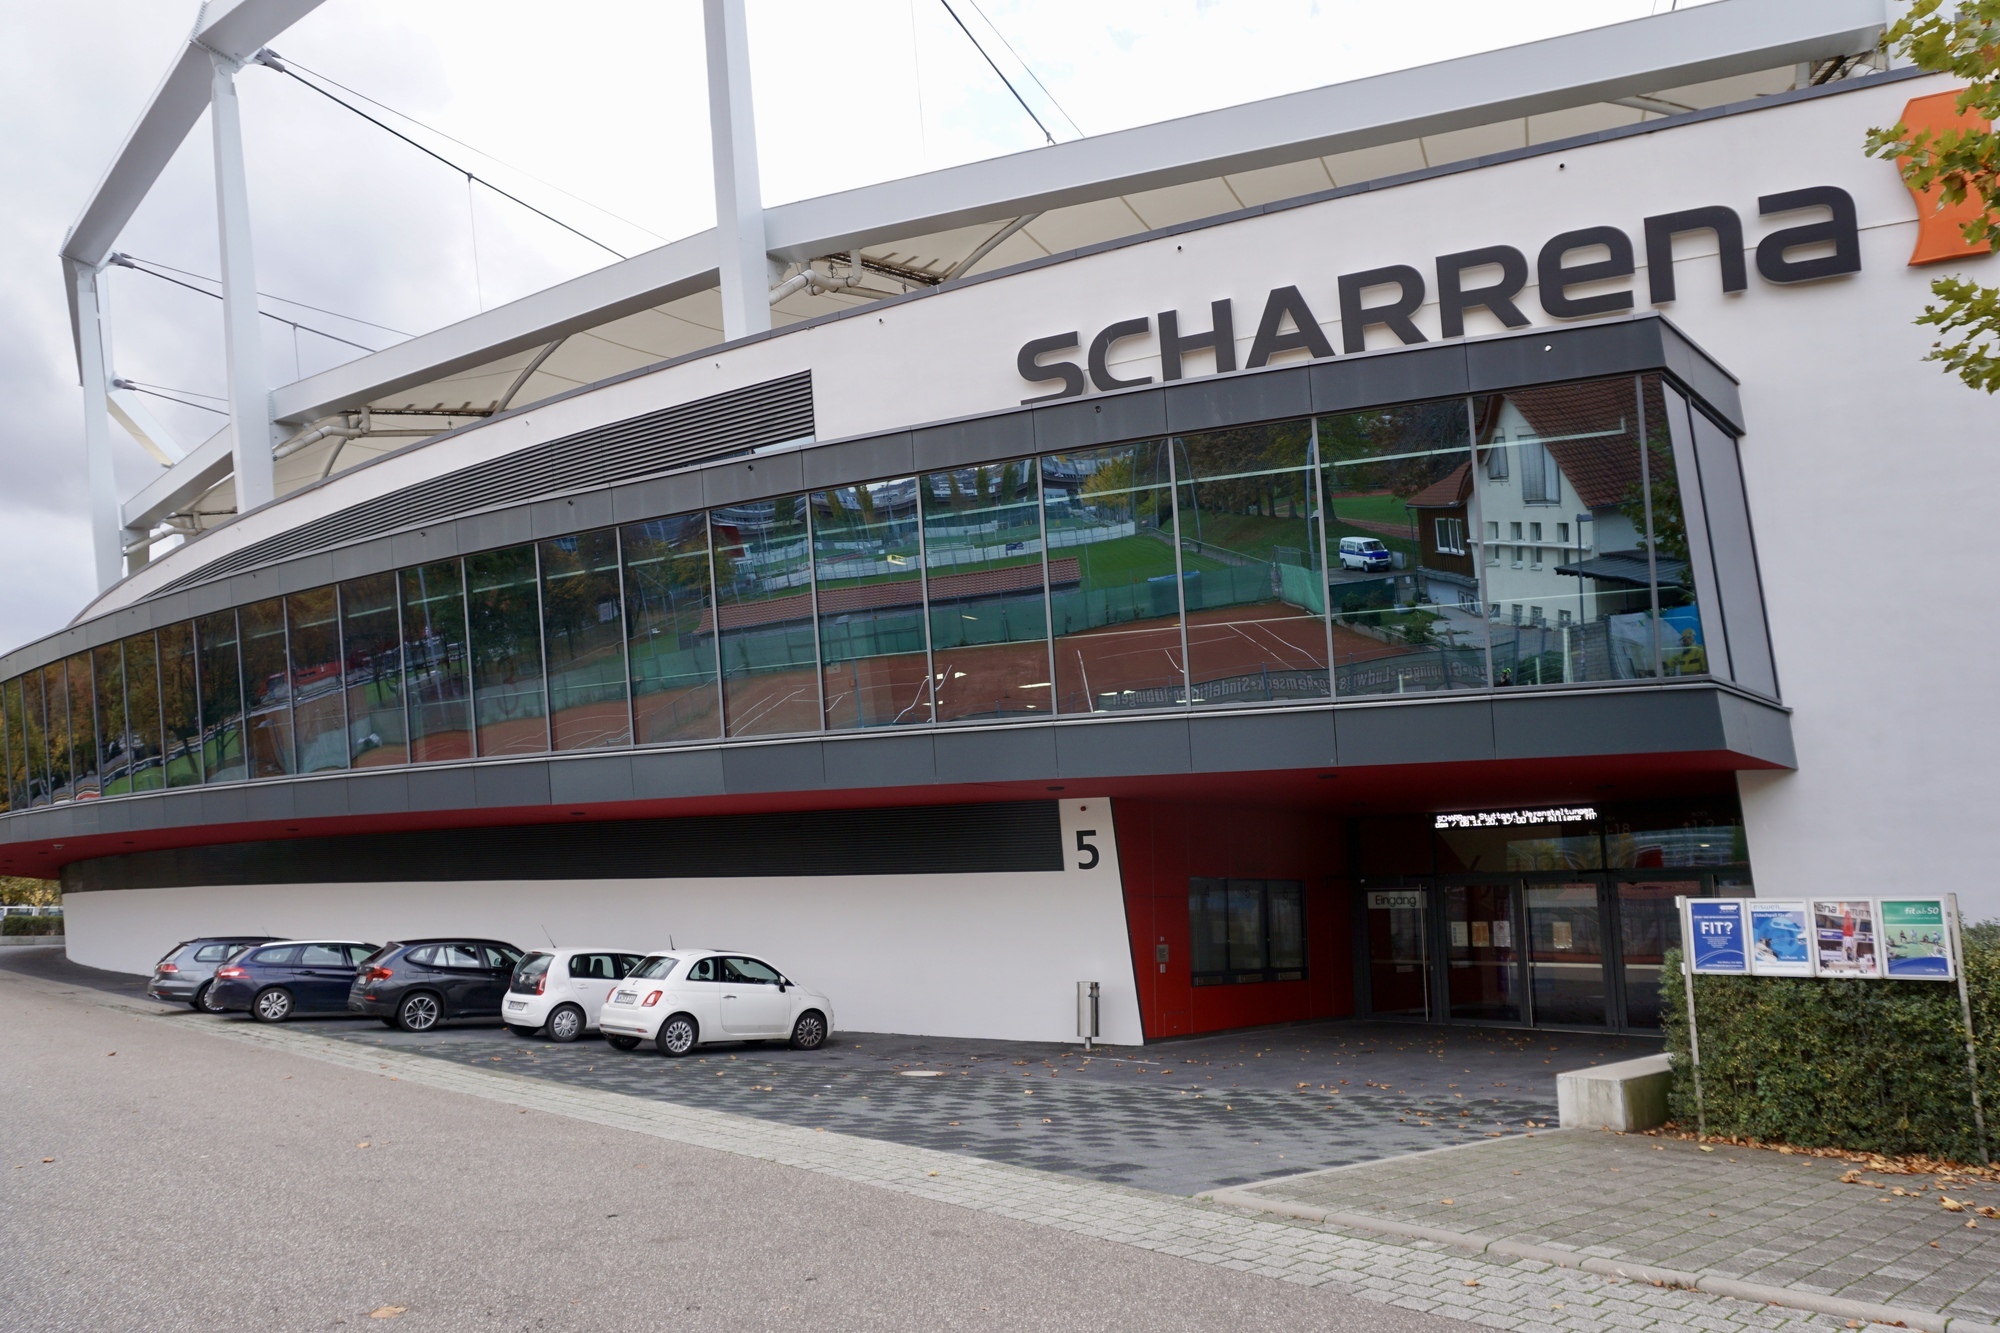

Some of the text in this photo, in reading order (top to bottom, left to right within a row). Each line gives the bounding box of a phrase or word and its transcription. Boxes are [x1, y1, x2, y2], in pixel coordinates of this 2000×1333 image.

[1017, 185, 1862, 405] SCHARRena
[1076, 829, 1100, 870] 5
[1375, 895, 1417, 907] Eingang
[1904, 907, 1916, 915] fit
[1928, 906, 1939, 915] 50
[1701, 921, 1733, 934] FIT?
